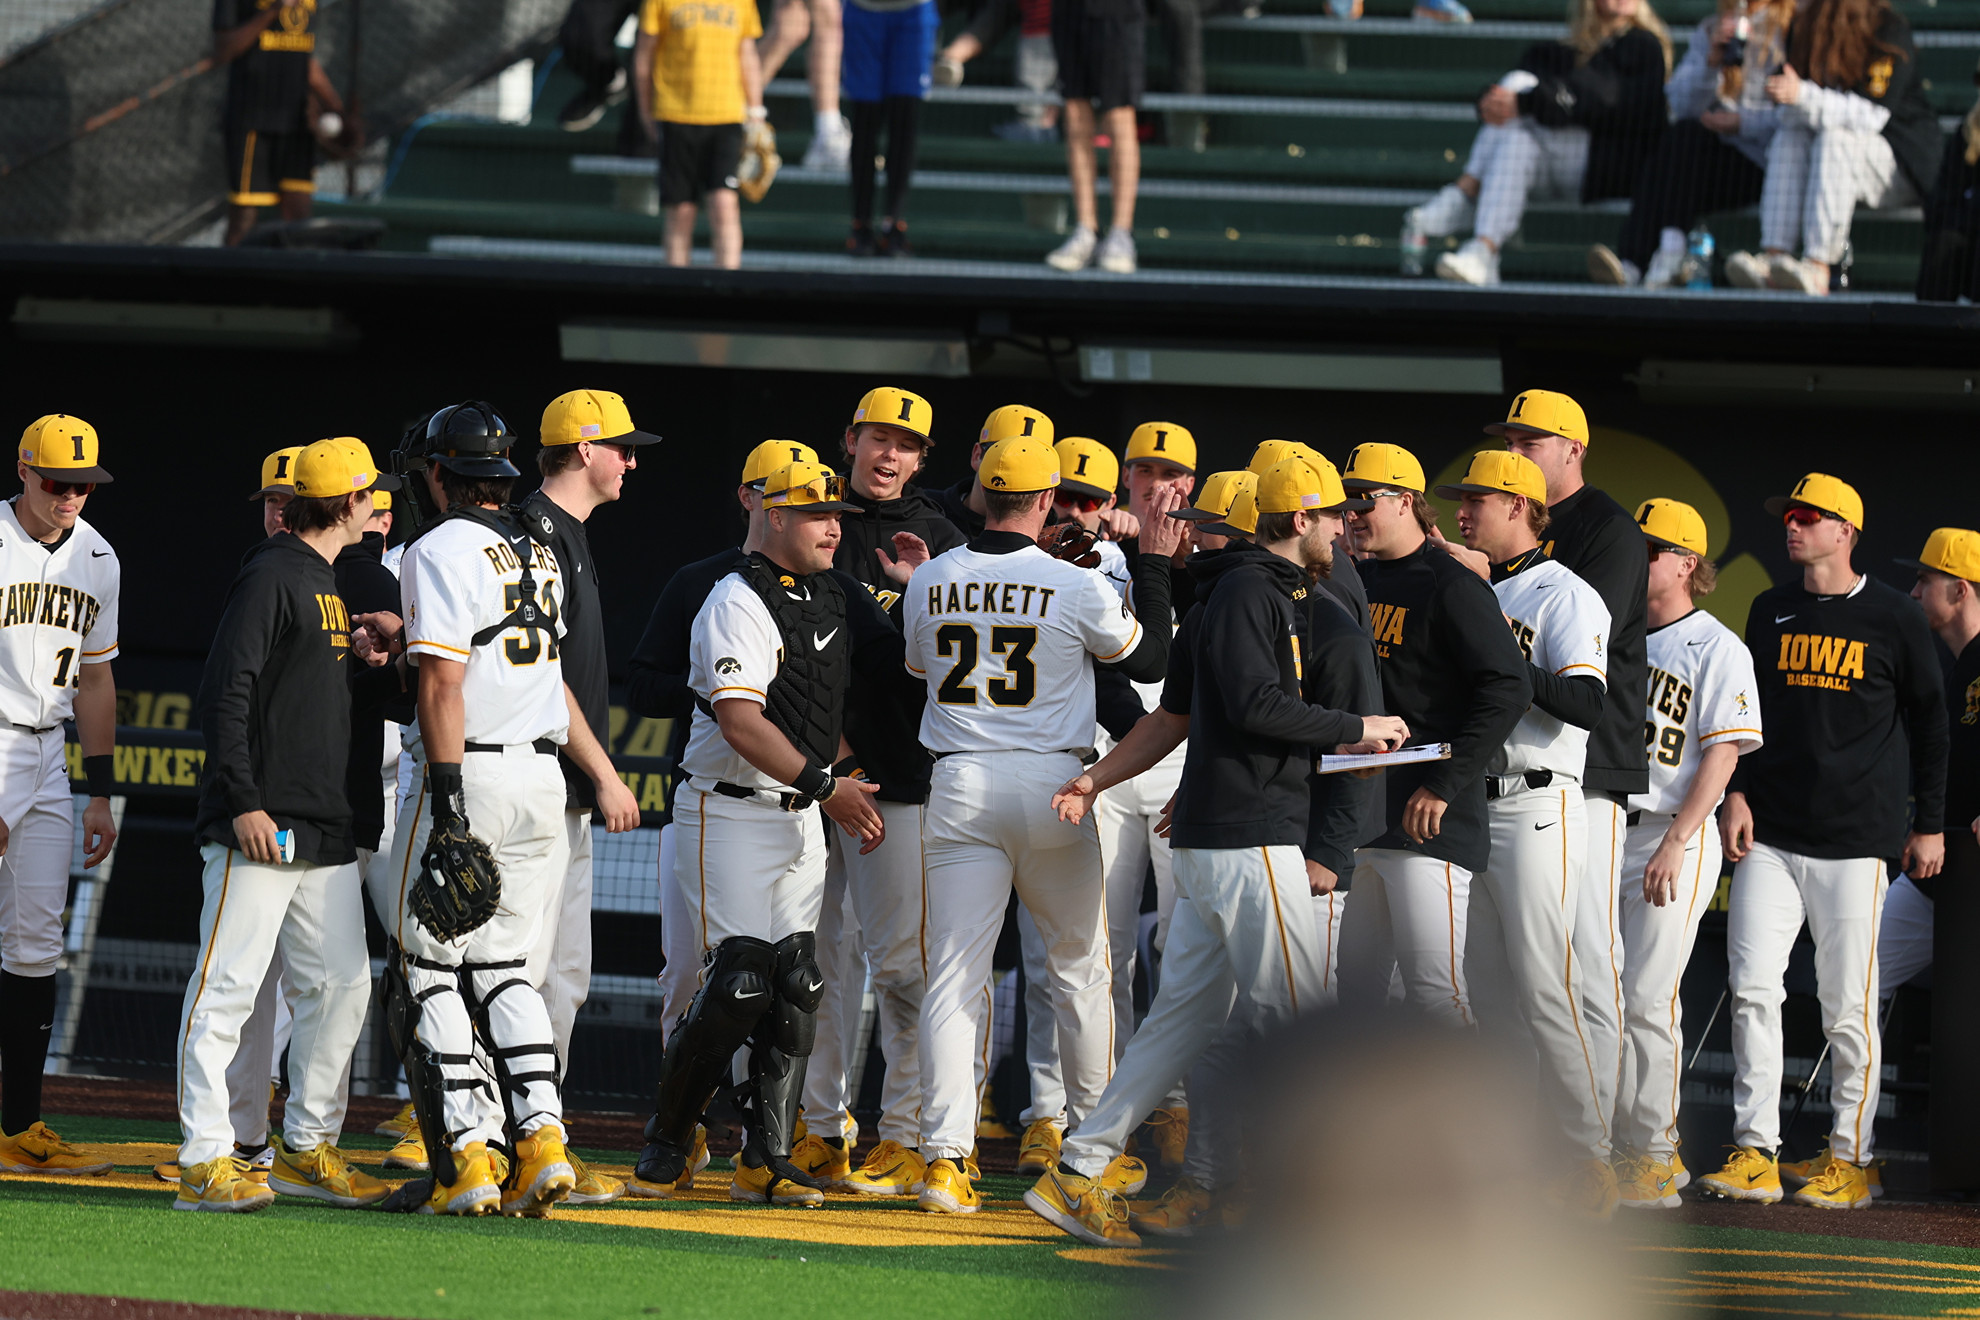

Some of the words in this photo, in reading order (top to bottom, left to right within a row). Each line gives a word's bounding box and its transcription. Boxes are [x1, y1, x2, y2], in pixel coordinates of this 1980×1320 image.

[898, 397, 914, 422] I
[1512, 396, 1528, 419] I
[1021, 417, 1036, 437] I
[71, 435, 85, 461] I
[1154, 430, 1168, 452] I
[274, 455, 291, 479] I
[1074, 454, 1090, 476] I
[1346, 449, 1361, 473] I
[1638, 503, 1656, 527] I
[483, 542, 559, 576] RORS
[0, 582, 101, 639] AWKEYES
[928, 582, 1056, 618] HACKETT
[935, 622, 1039, 708] 23
[1777, 633, 1865, 680] IOWA
[1786, 673, 1851, 692] BASEBALL
